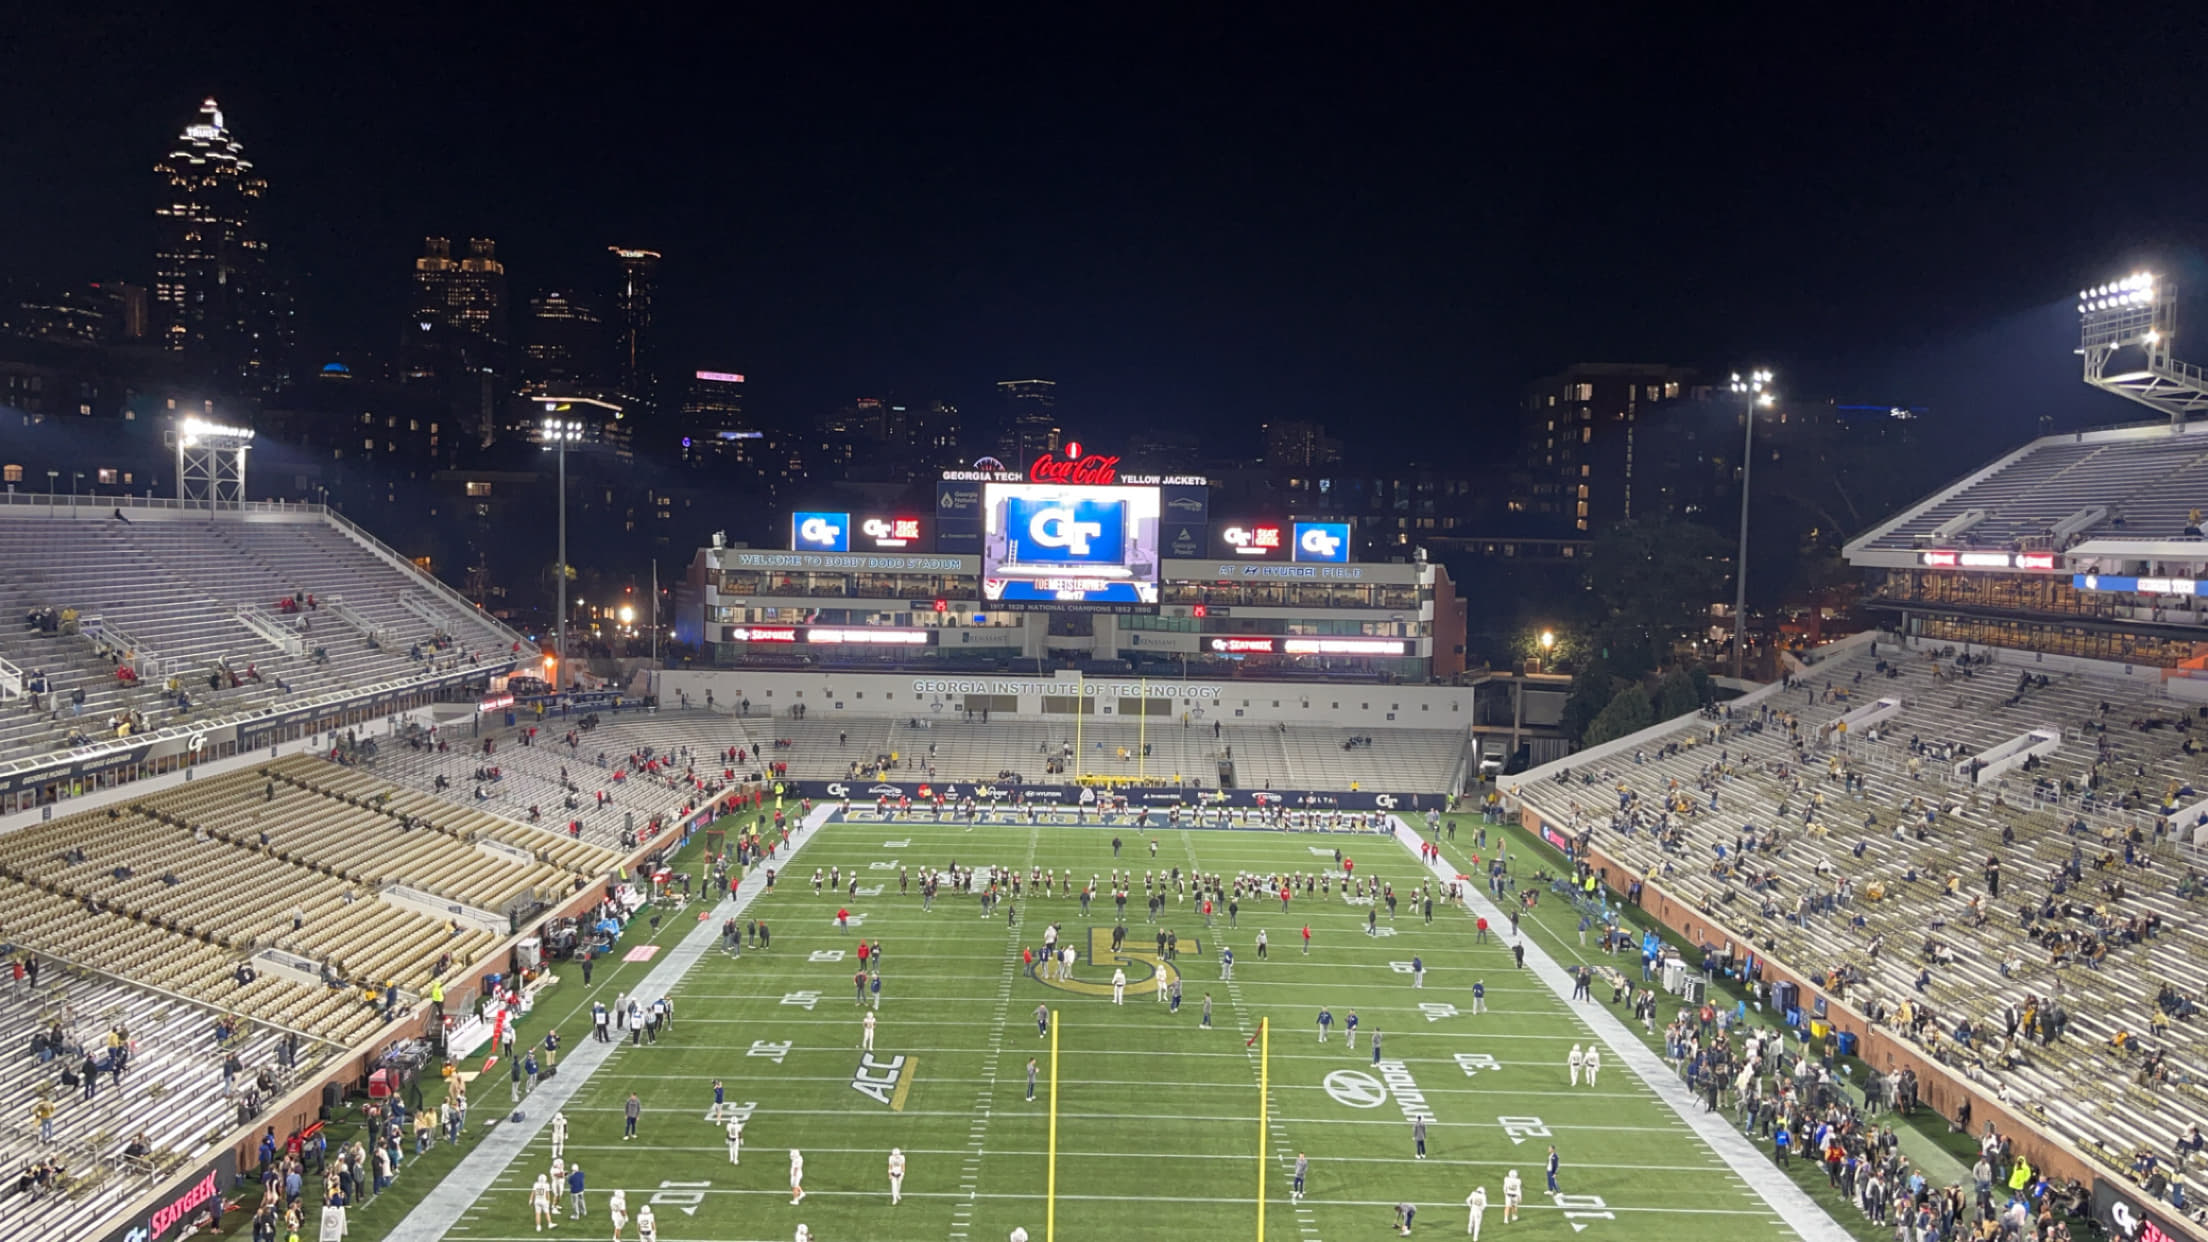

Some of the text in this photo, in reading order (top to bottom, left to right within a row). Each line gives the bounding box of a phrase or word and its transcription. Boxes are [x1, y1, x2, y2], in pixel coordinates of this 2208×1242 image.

[420, 322, 432, 331] W
[942, 471, 1023, 481] GEORGIA TECH
[1120, 475, 1207, 485] YELLOW JACKETS
[739, 554, 961, 570] WELCOME TO BOBBY DODD STADIUM
[1219, 566, 1362, 578] AT HYUNDAI FIELD
[913, 680, 1223, 699] GEORGIA INSTITUTE OF TECHNOLOGY
[827, 783, 850, 797] GT
[1376, 794, 1398, 808] GT
[851, 1052, 905, 1105] ACC
[1379, 1060, 1437, 1122] HYUNDAI
[1497, 1116, 1552, 1137] 20
[650, 1180, 712, 1204] 10
[151, 1169, 217, 1240] SEATGEEK
[1552, 1194, 1616, 1220] 10
